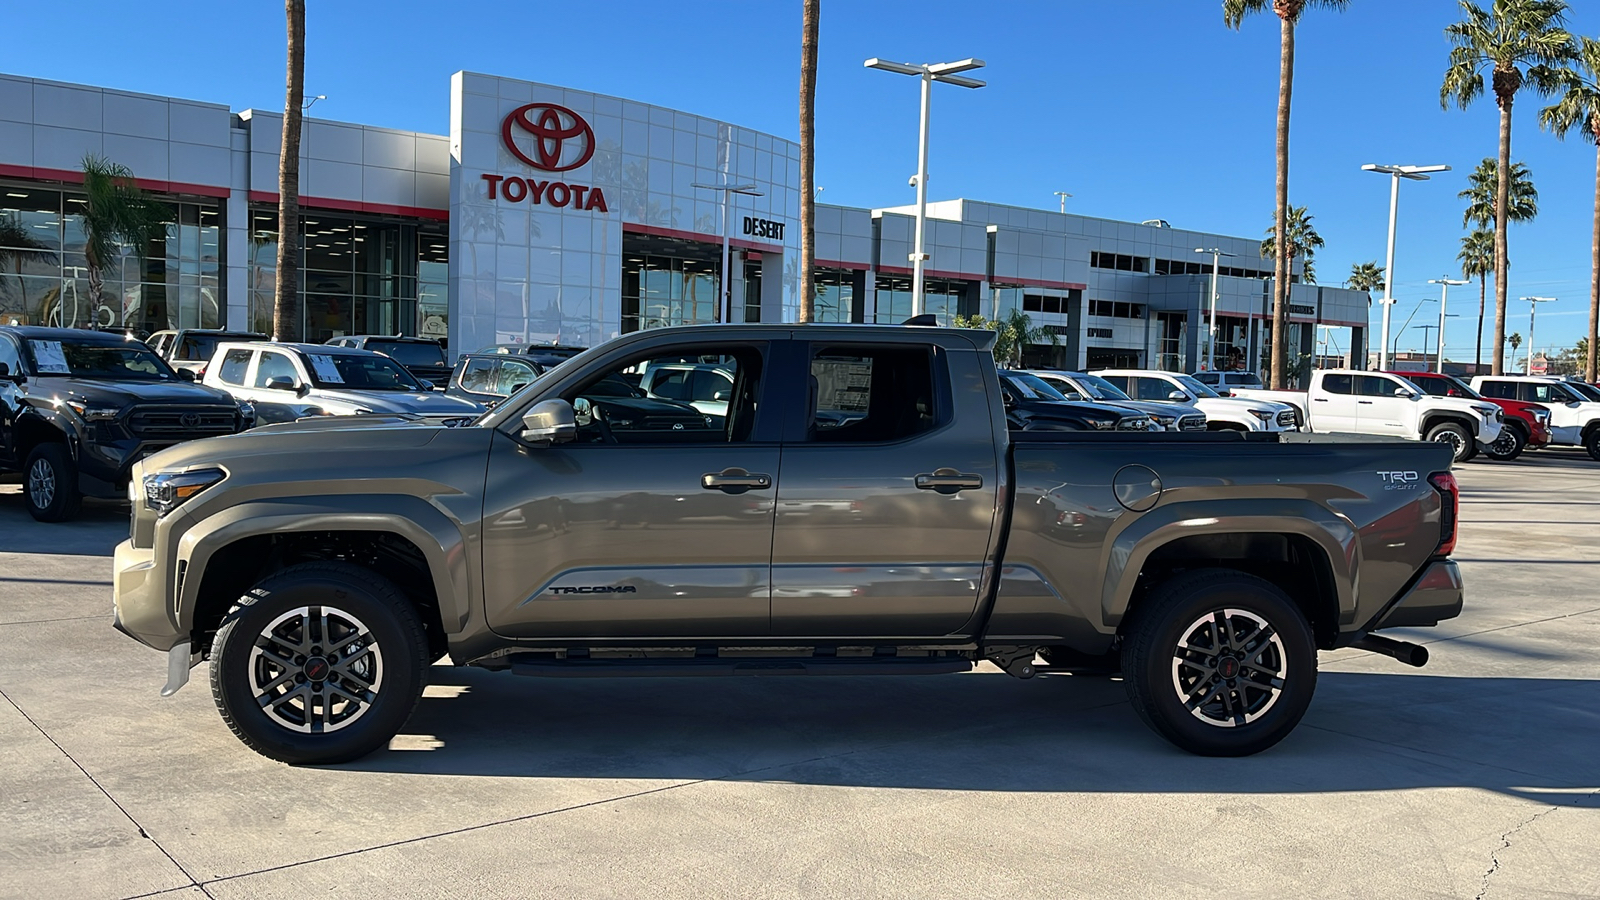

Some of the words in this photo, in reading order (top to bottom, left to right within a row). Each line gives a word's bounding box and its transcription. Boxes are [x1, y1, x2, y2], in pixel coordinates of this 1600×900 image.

[481, 173, 608, 213] TOYOTA
[743, 216, 786, 241] DESERT
[1376, 471, 1419, 484] TRD
[548, 585, 637, 594] TACOMA
